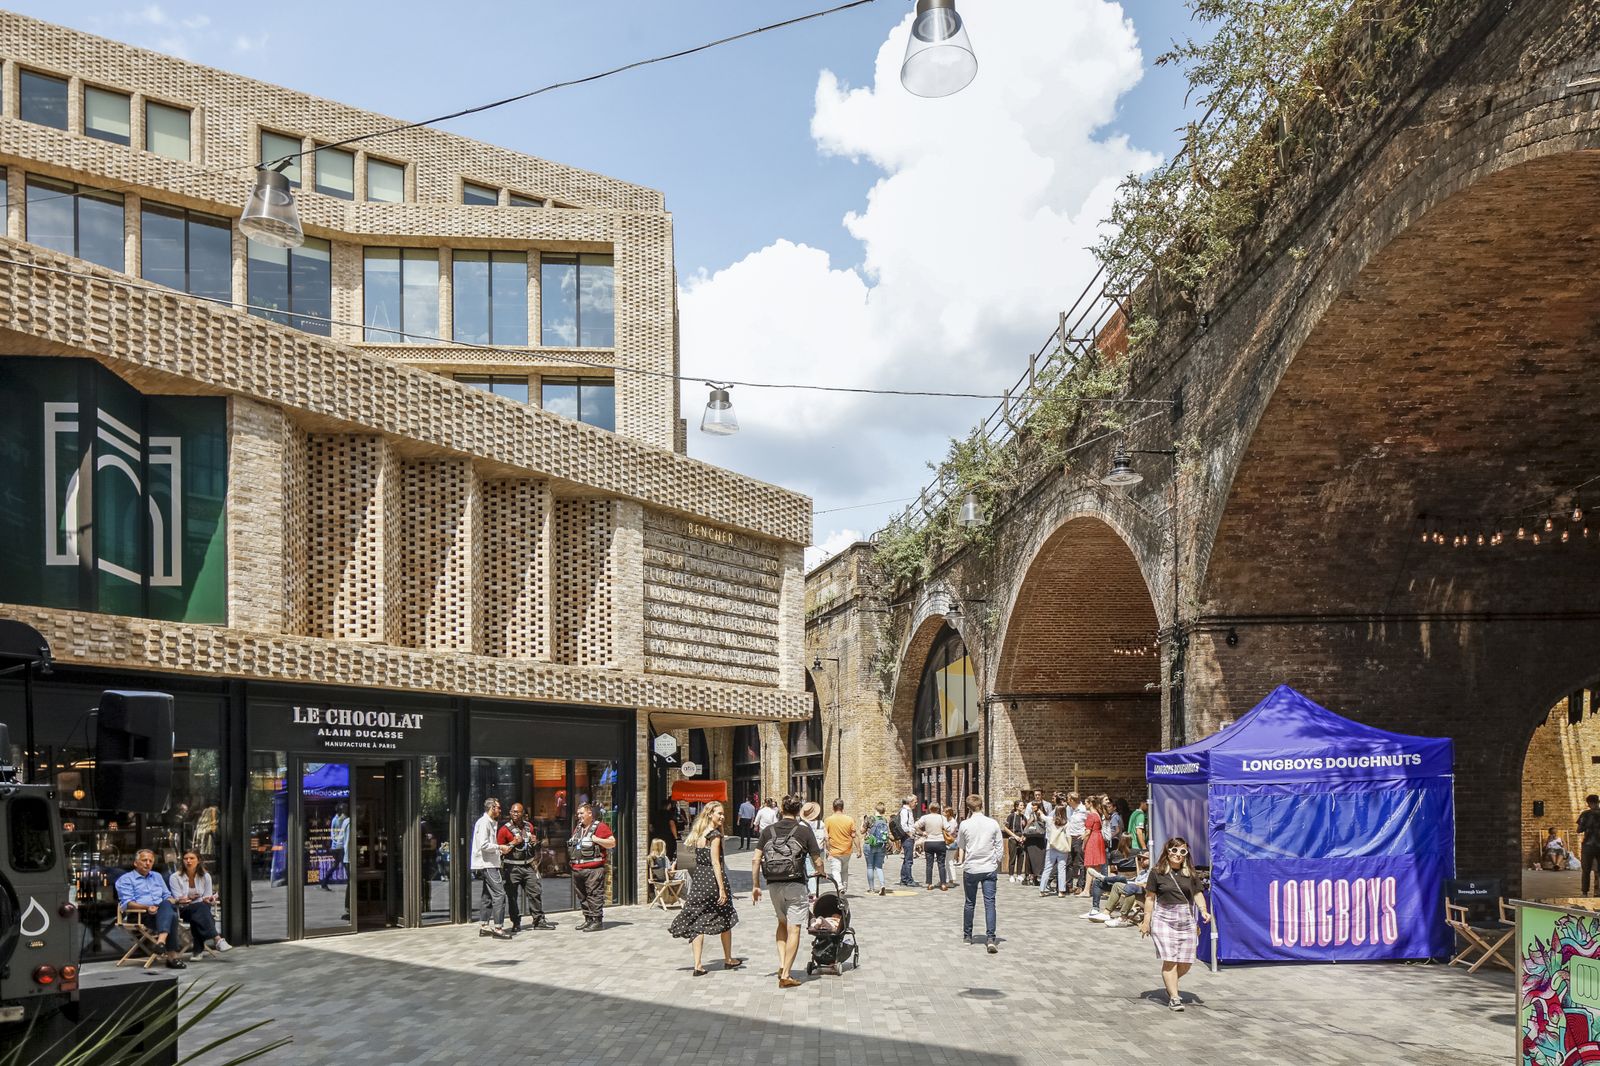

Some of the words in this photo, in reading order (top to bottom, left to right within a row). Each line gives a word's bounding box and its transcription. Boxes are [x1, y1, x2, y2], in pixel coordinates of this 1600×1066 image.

[688, 522, 733, 544] BENCHER
[293, 706, 320, 724] LE
[325, 709, 423, 729] CHOCOLAT
[318, 728, 351, 737] ALAIN
[355, 730, 404, 739] DUCASSE
[324, 741, 371, 749] MANUFACTURE
[1242, 757, 1323, 772] LONGBOYS
[1325, 753, 1422, 769] DOUGHNUTS
[1269, 876, 1398, 947] LONGBOYS
